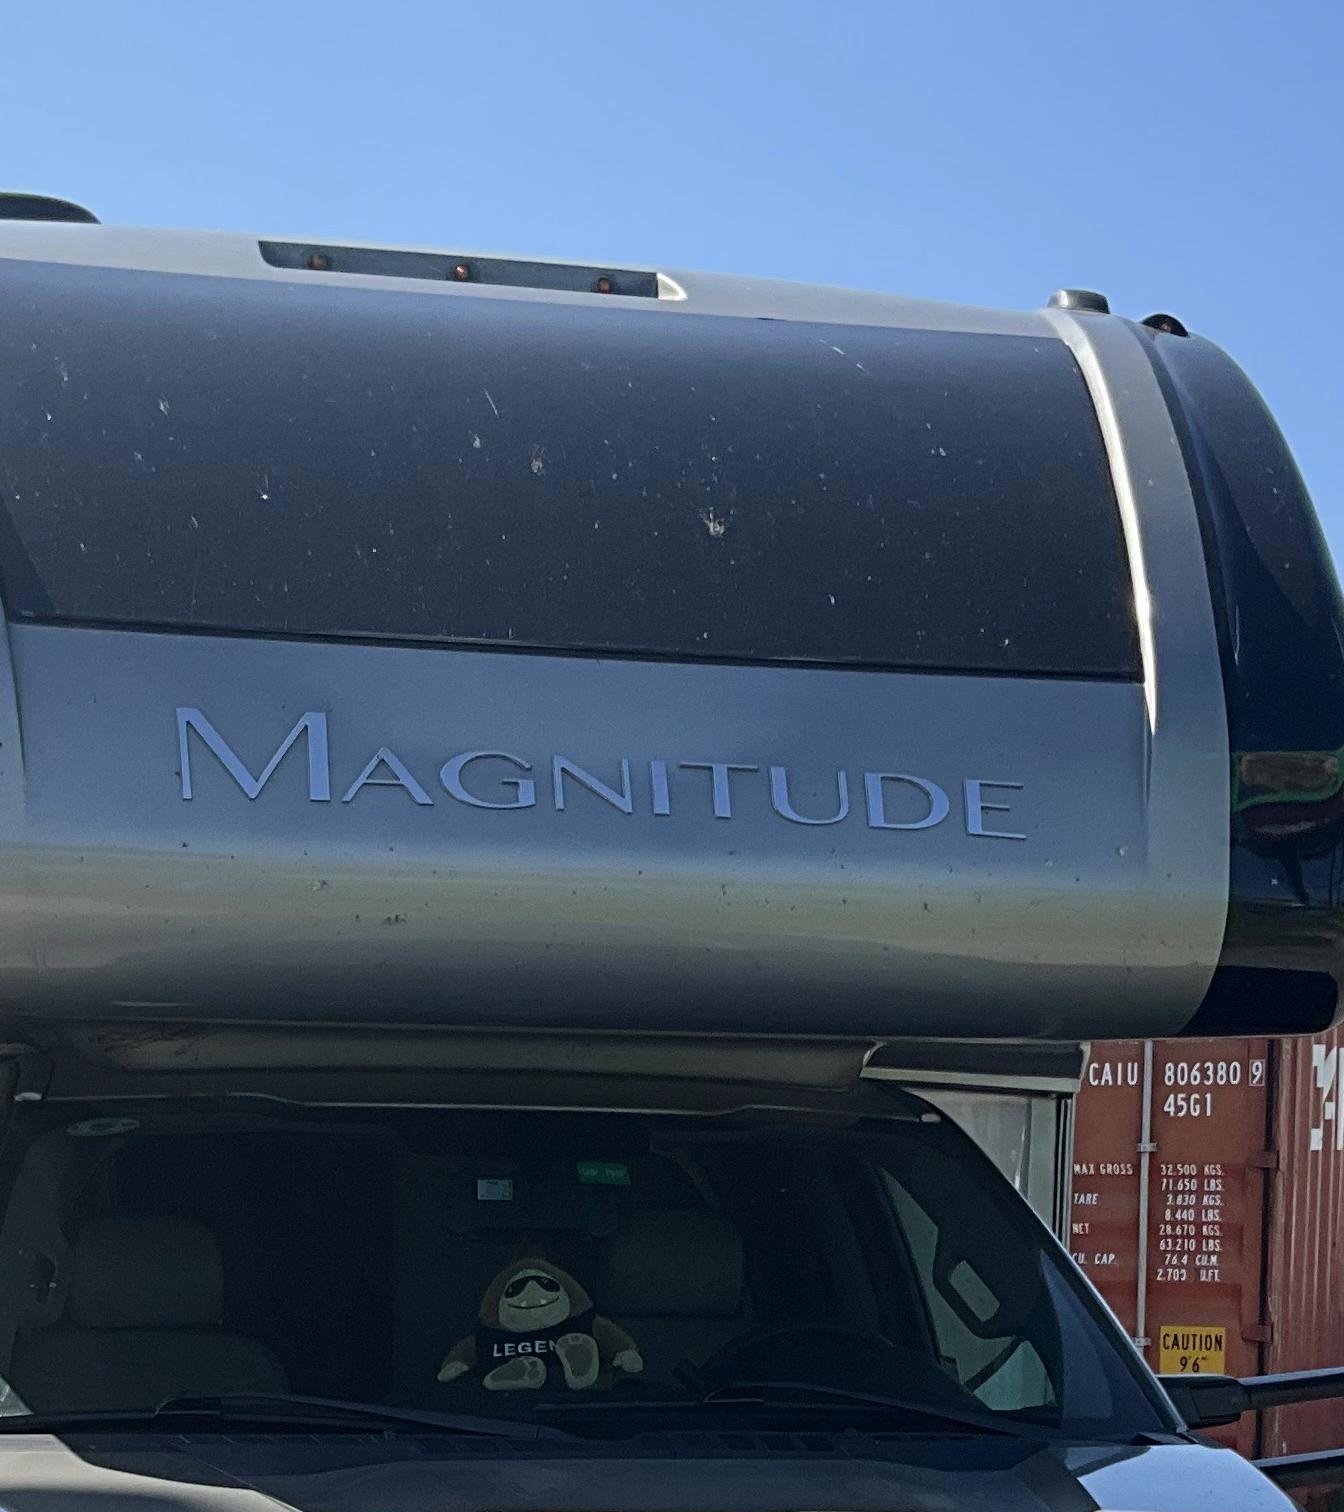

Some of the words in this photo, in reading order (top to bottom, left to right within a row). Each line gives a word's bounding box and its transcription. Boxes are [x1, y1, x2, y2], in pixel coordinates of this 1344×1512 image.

[175, 706, 1028, 841] MAGNITUDE
[1089, 1062, 1138, 1086] CAIU
[1164, 1061, 1242, 1086] 806380
[1251, 1061, 1263, 1085] 9
[1163, 1092, 1212, 1117] 45G1
[1099, 1163, 1134, 1176] GROSS
[1073, 1193, 1100, 1205] TARE
[1072, 1223, 1090, 1235] NET
[492, 1340, 558, 1357] LEGEN
[1162, 1333, 1223, 1351] CAUTION
